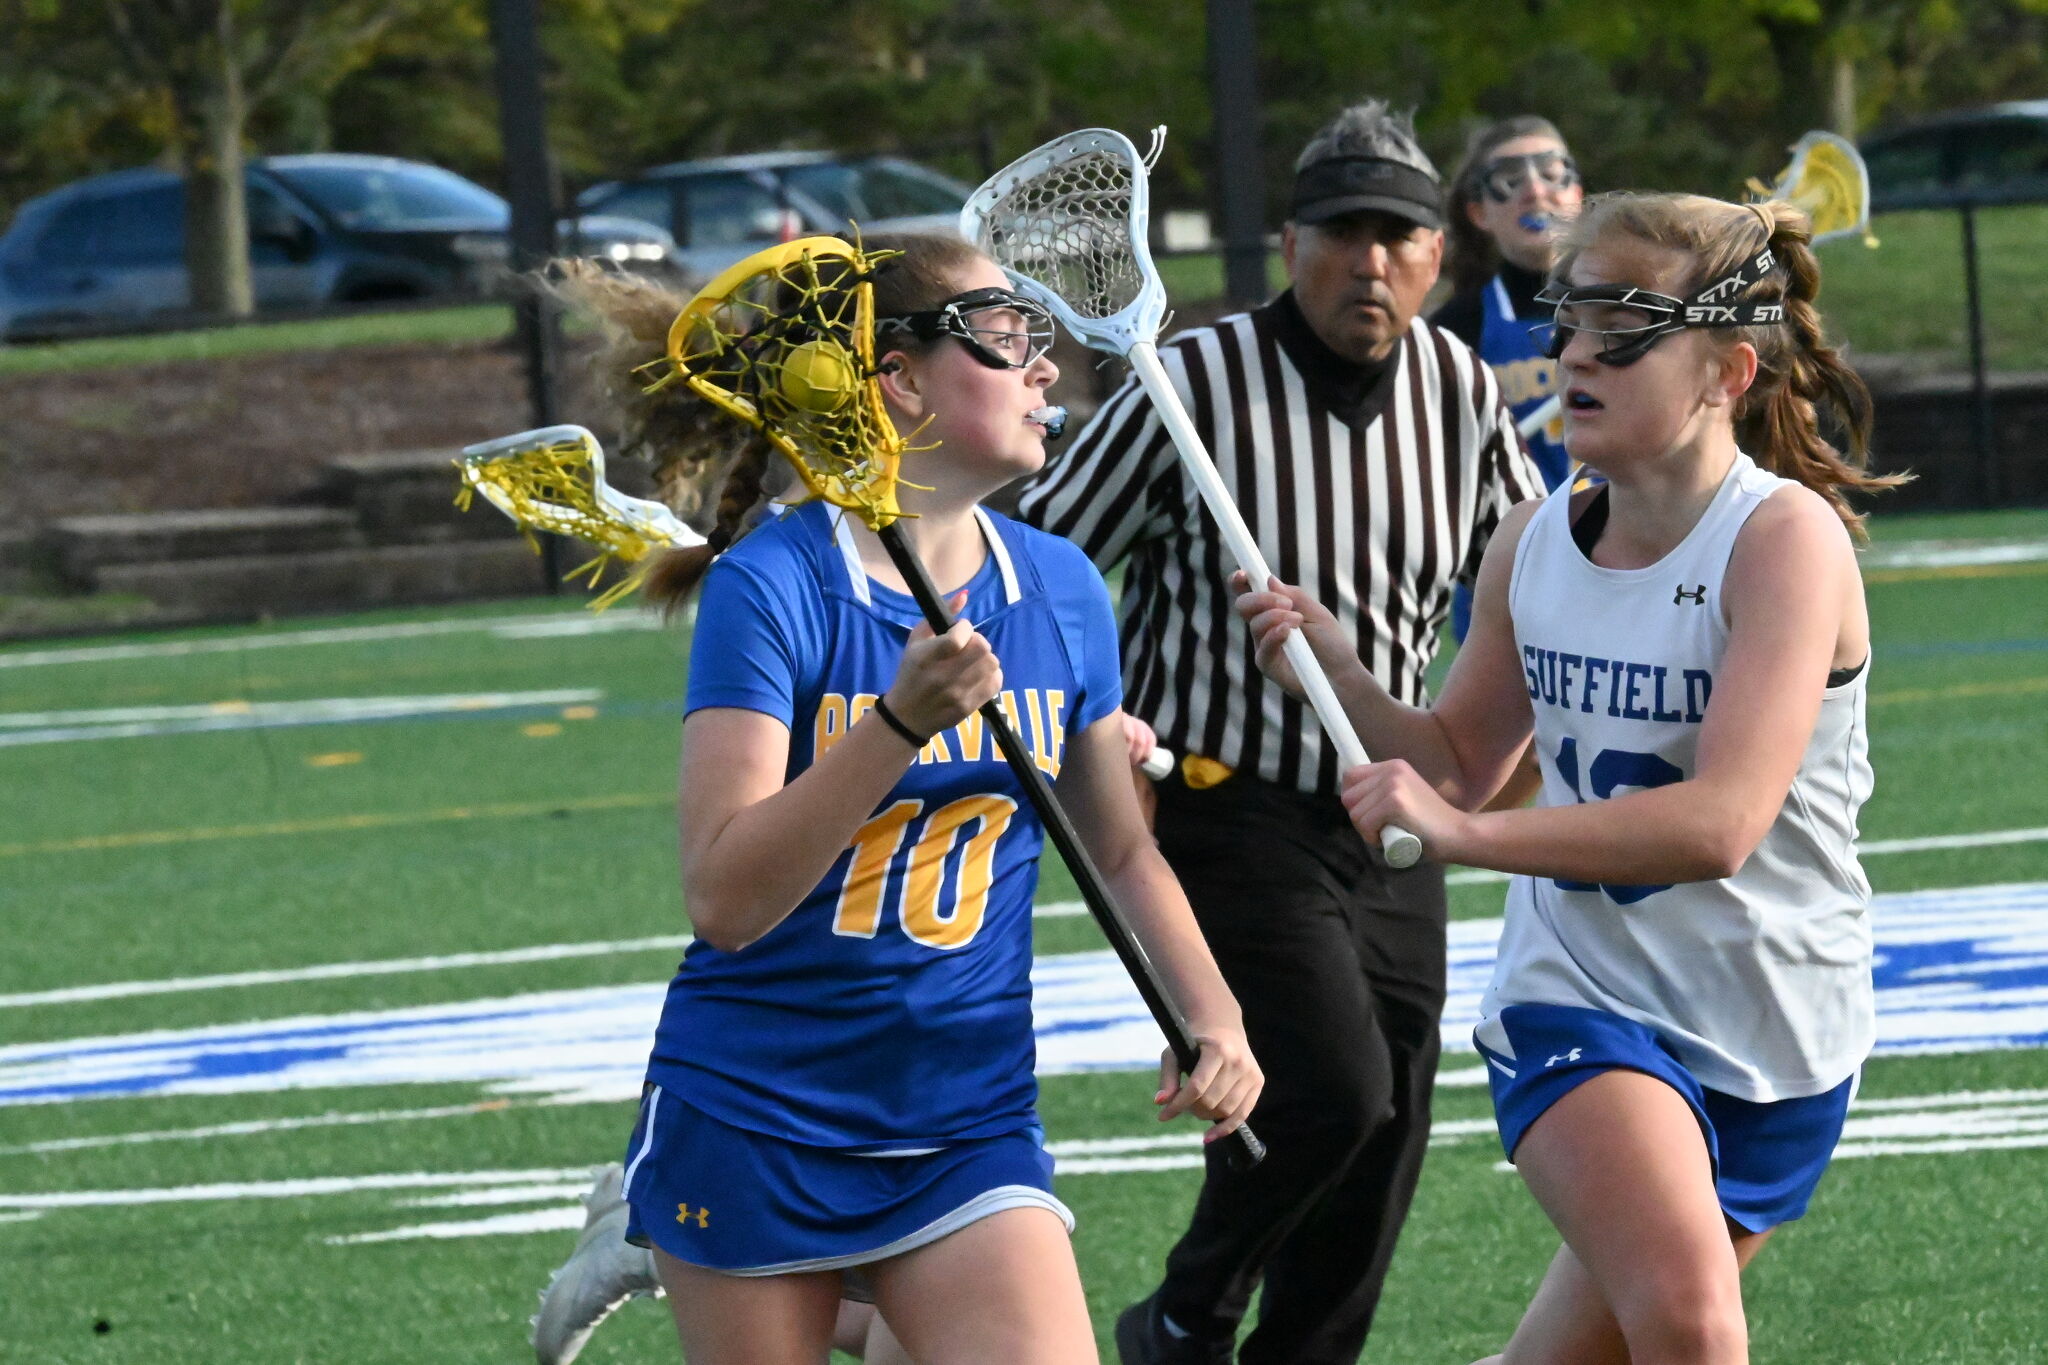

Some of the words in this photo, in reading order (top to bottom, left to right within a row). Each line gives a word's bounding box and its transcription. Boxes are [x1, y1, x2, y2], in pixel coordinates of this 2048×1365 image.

[1697, 270, 1748, 303] STX
[875, 316, 914, 335] TX
[1686, 306, 1738, 322] STX
[1752, 305, 1783, 322] ST
[1523, 644, 1713, 723] SUFFIELD
[831, 793, 1018, 950] 10
